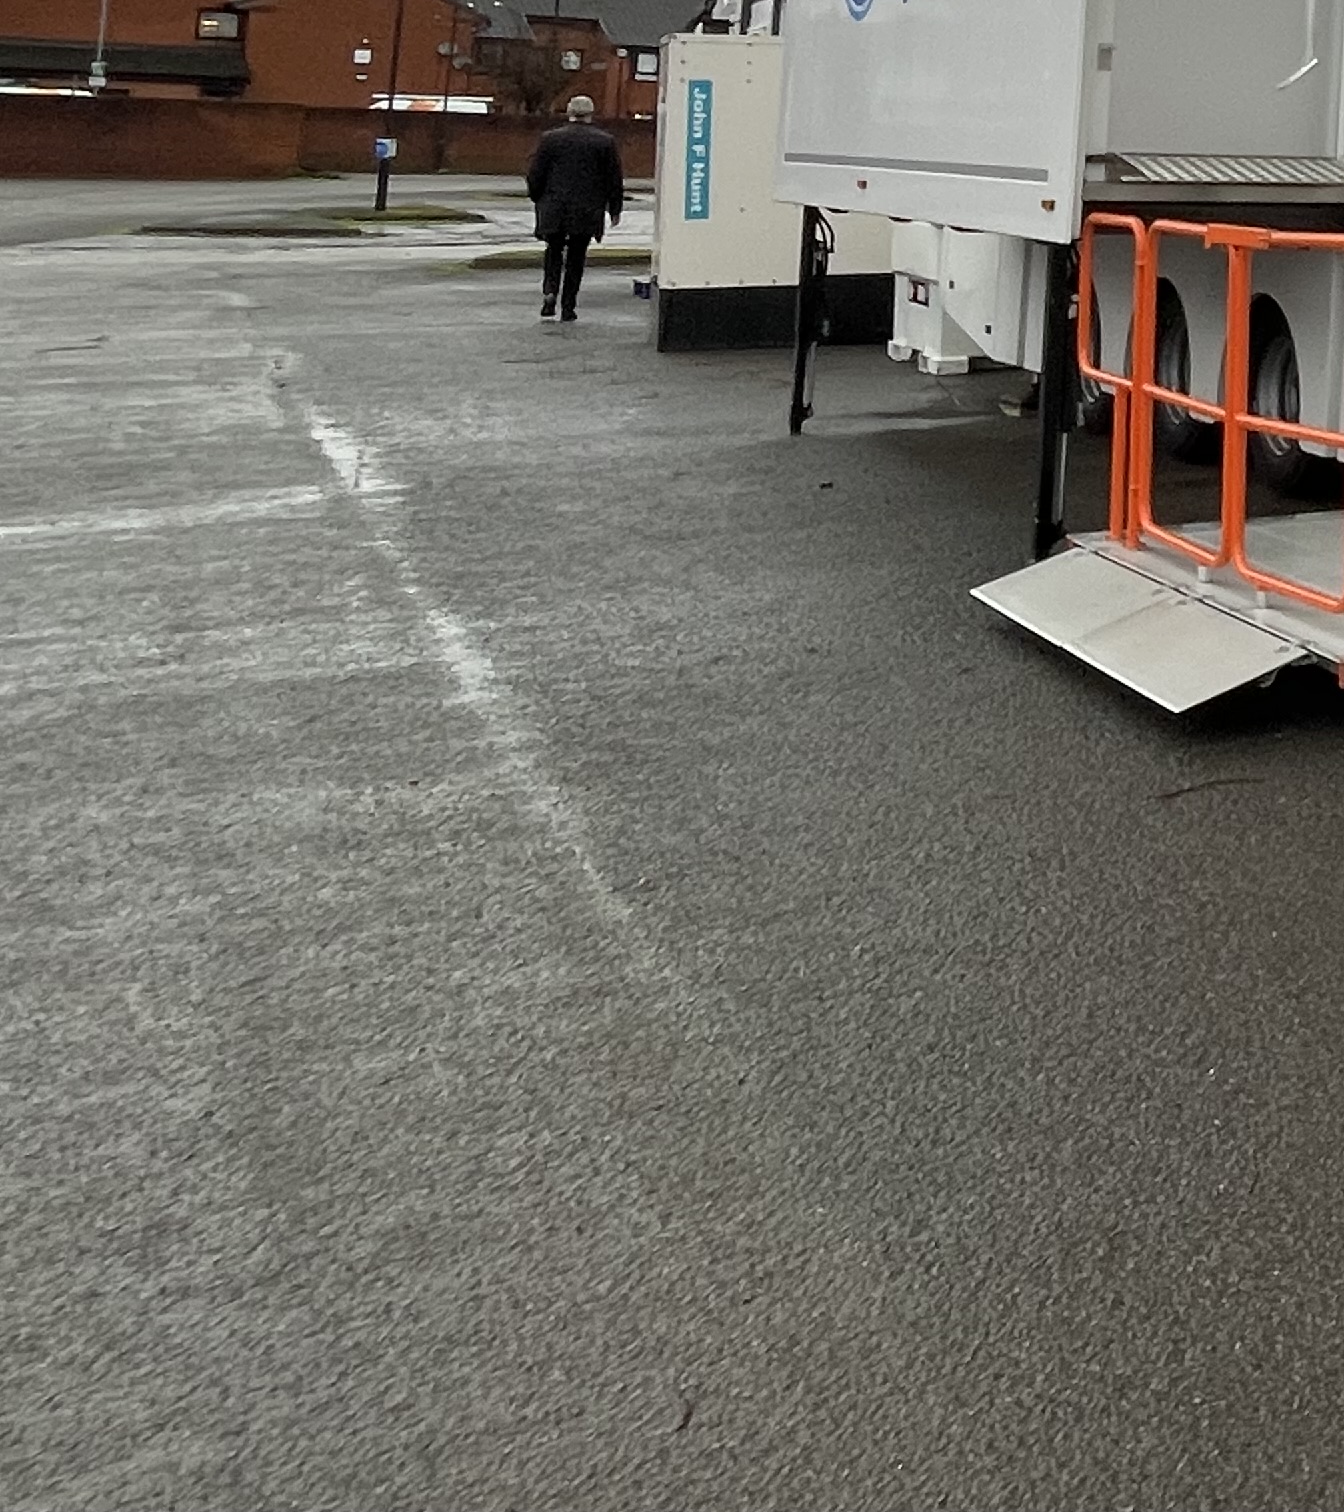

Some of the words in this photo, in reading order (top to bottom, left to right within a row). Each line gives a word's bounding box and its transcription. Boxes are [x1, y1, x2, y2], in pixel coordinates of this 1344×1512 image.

[693, 87, 707, 138] John
[692, 144, 706, 157] F
[691, 162, 705, 213] Hunt
